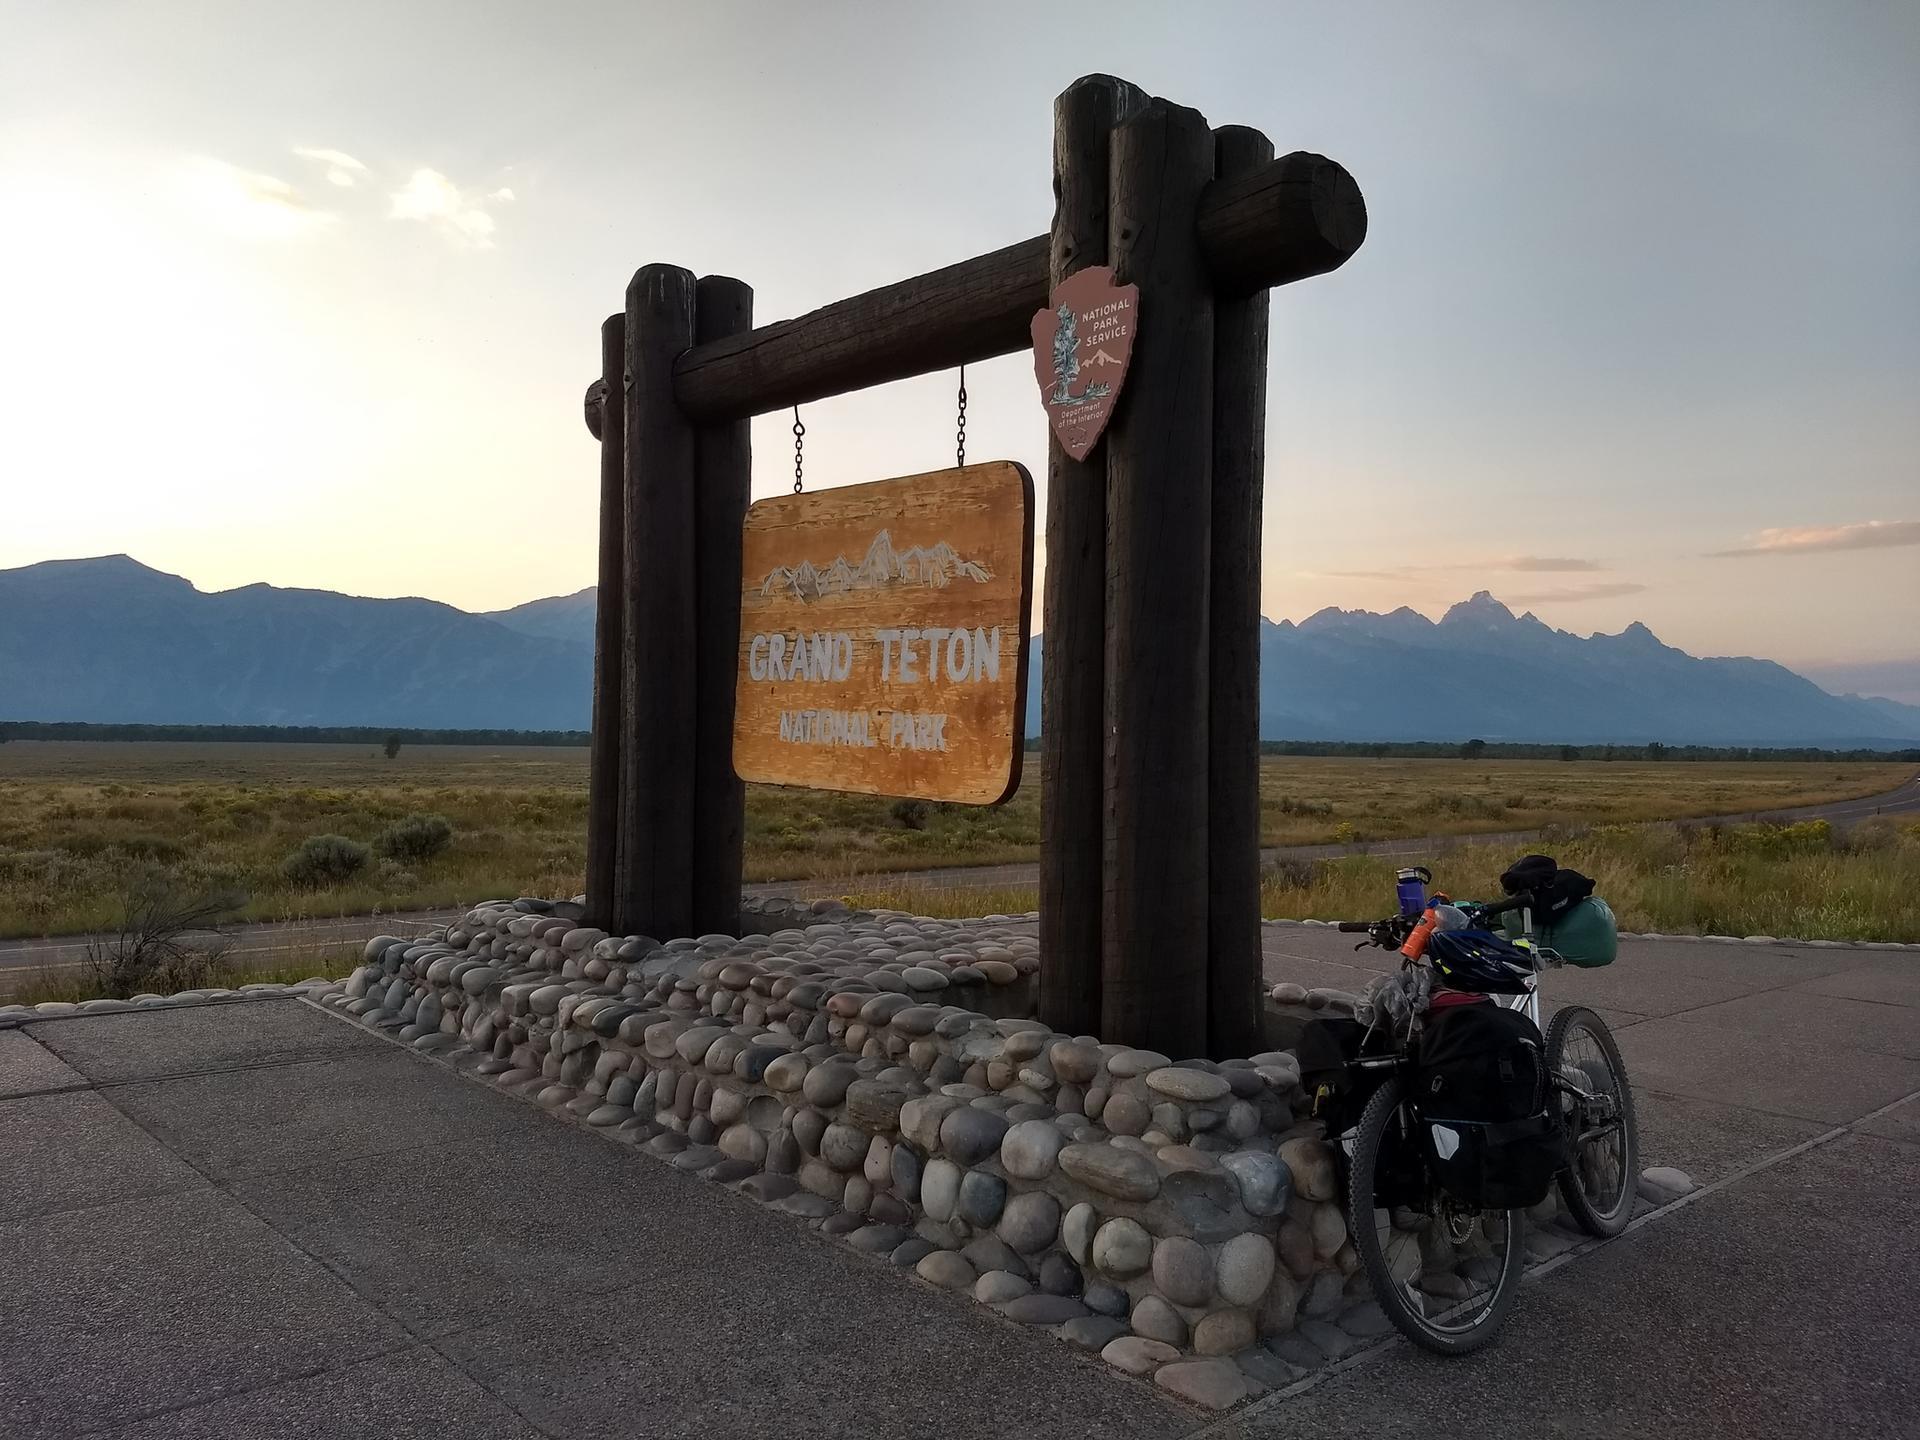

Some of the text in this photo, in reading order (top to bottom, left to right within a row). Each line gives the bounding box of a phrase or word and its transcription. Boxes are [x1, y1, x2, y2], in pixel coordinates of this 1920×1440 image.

[1082, 299, 1130, 322] NATIONAL
[1093, 315, 1118, 332] PARK
[1086, 325, 1127, 347] SERVICE
[1058, 420, 1065, 428] of
[1078, 410, 1104, 423] Interior
[1061, 402, 1100, 419] Department
[750, 626, 1000, 683] GRAND TETON
[780, 709, 949, 752] NATIONAL PARK
